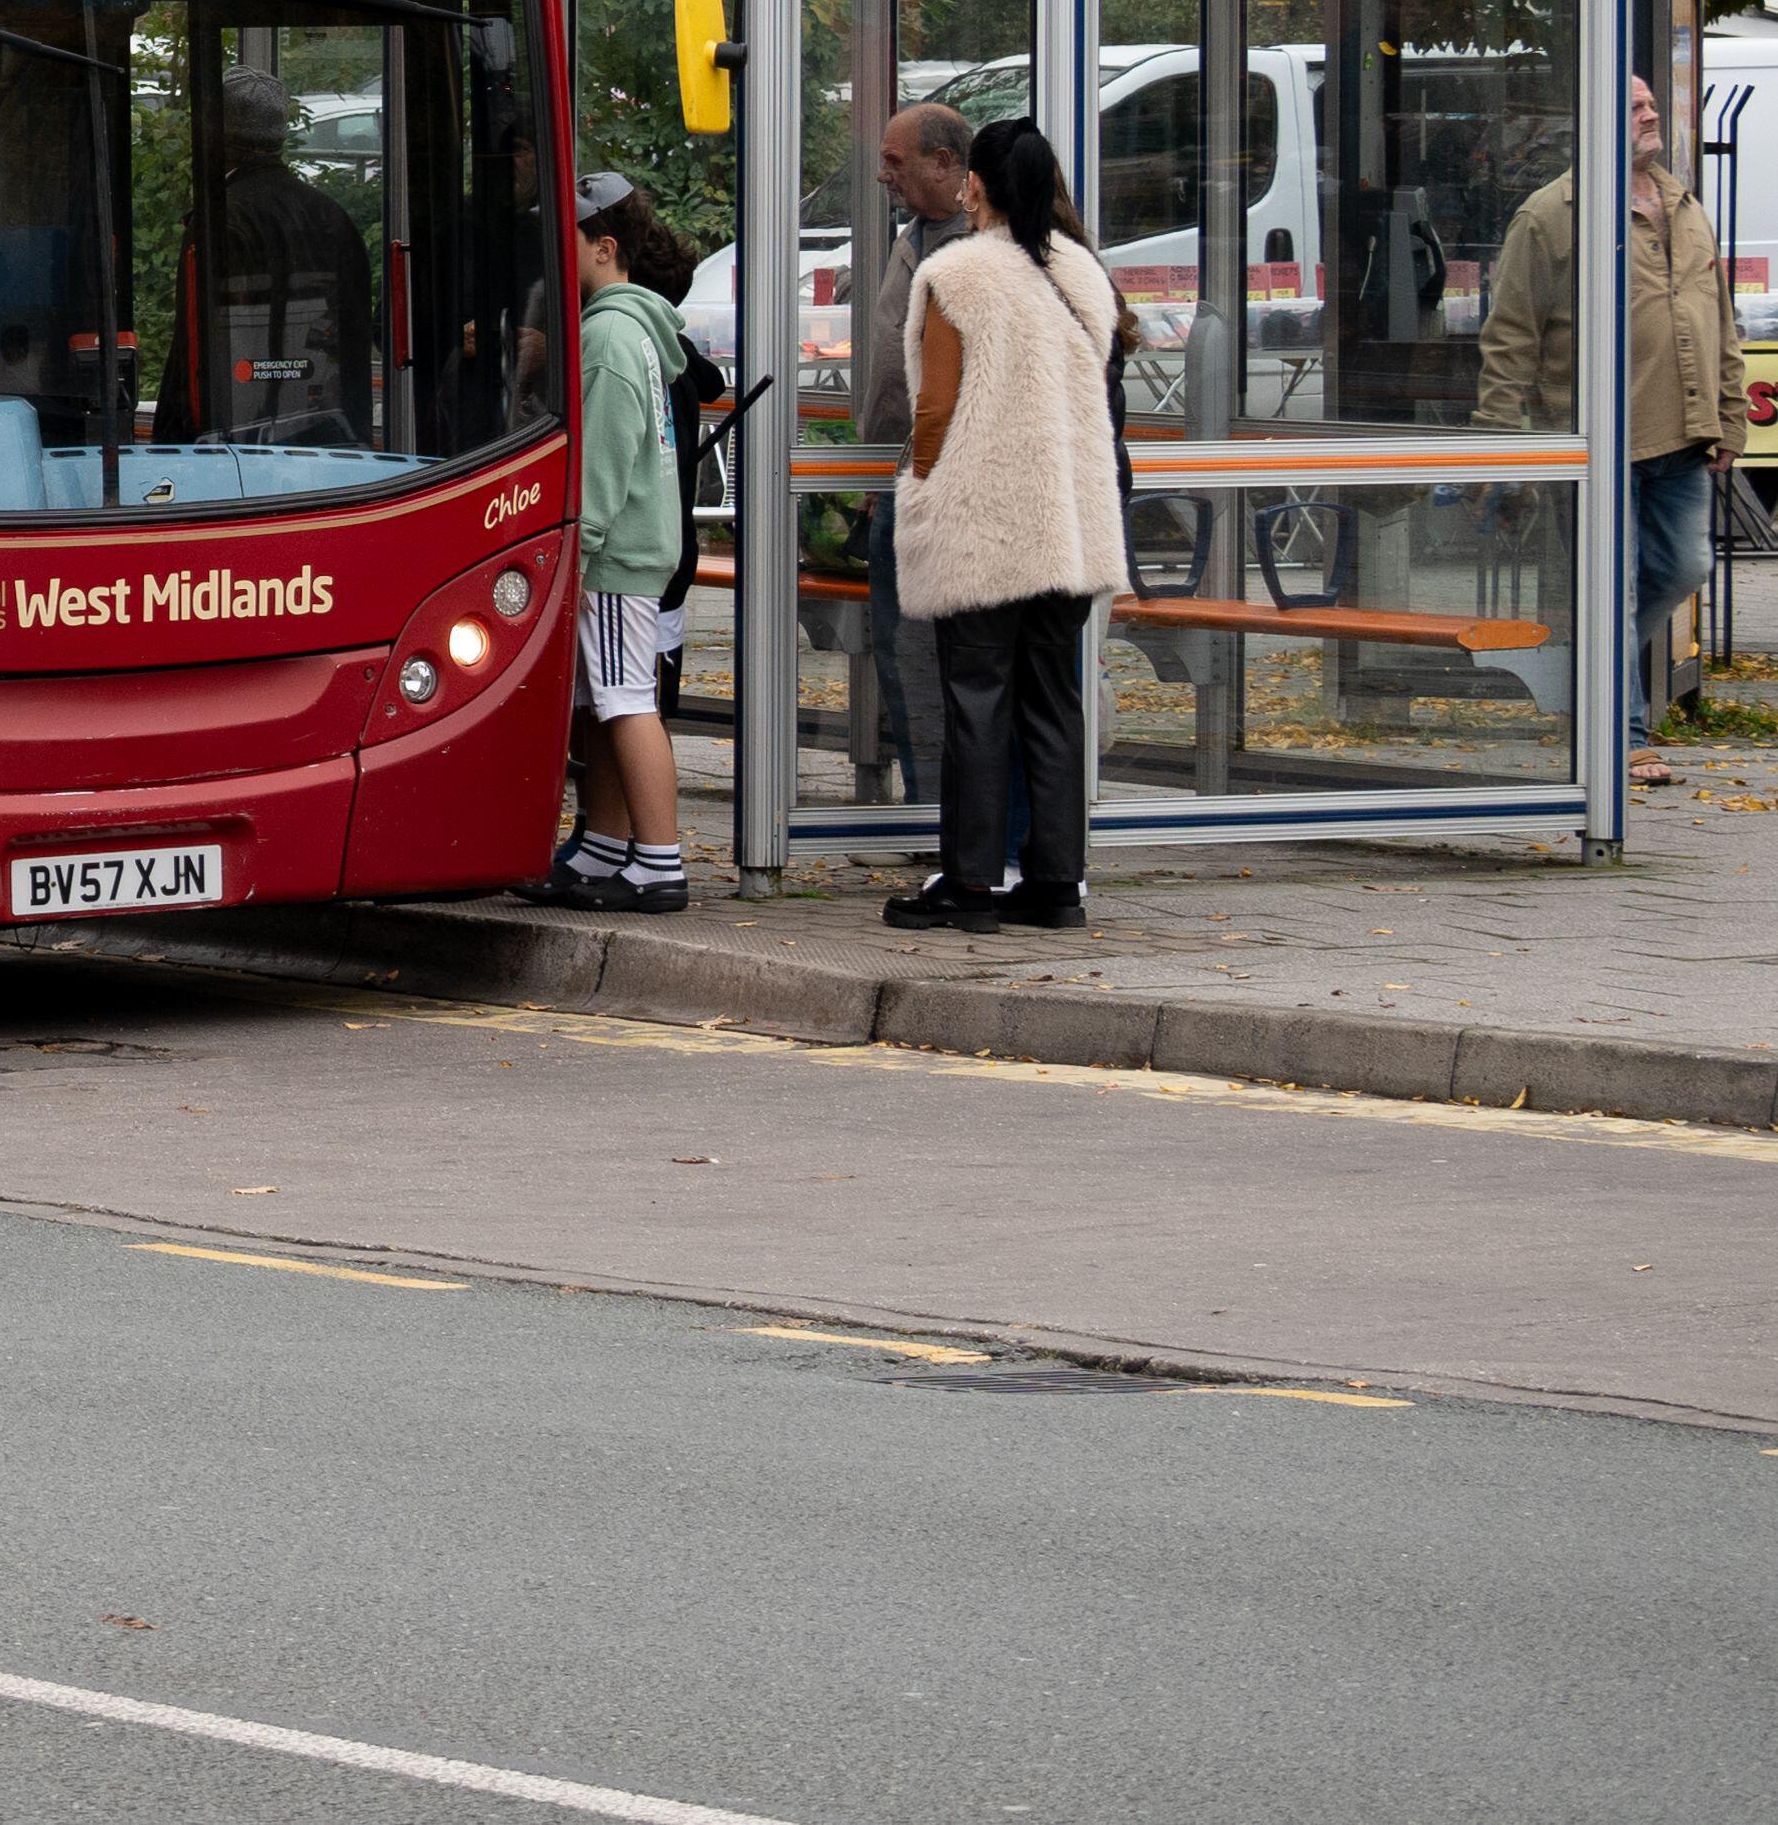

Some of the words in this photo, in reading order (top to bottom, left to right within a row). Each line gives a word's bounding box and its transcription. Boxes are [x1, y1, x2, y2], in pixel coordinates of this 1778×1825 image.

[253, 370, 272, 380] PUSH
[273, 370, 282, 379] TO
[283, 370, 301, 379] OPEN
[484, 482, 541, 529] Chloe
[14, 577, 131, 628] West
[143, 564, 334, 623] Midlands
[29, 859, 124, 906] BV57
[135, 854, 206, 899] XJN
